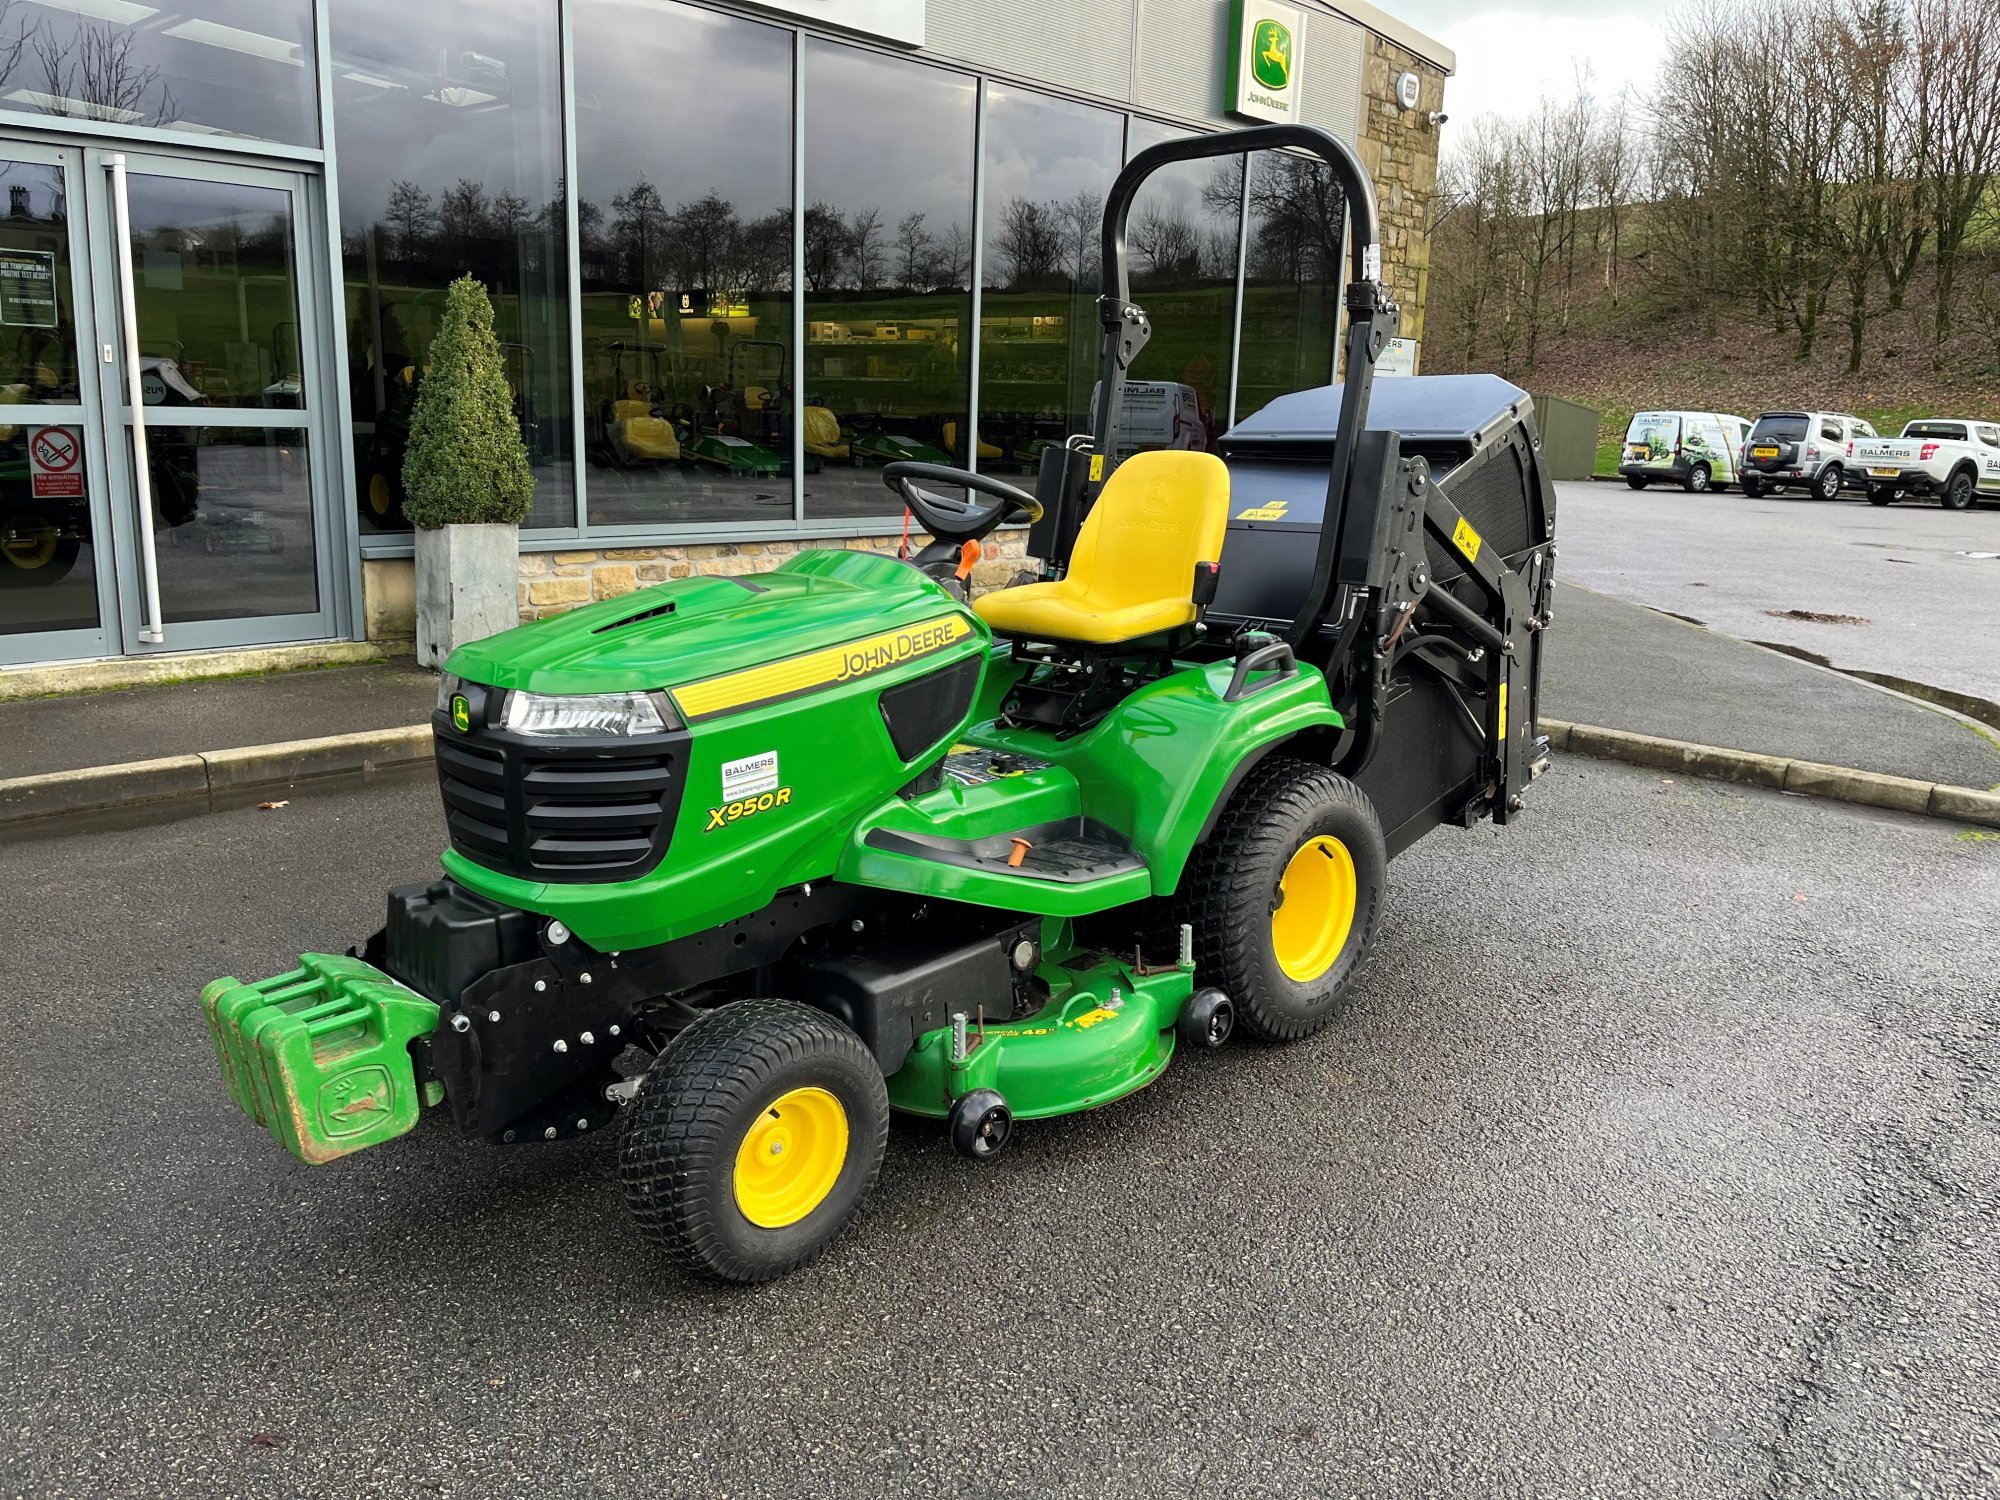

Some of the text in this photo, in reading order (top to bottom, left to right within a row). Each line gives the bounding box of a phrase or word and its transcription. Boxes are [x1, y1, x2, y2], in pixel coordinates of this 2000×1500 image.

[1247, 91, 1289, 112] JOHN DEERE
[1702, 423, 1734, 432] BALMERS
[1859, 449, 1911, 457] BALMERS
[1986, 459, 2000, 469] BA
[837, 623, 955, 678] JOHN DEERE
[724, 758, 775, 777] BALMERS
